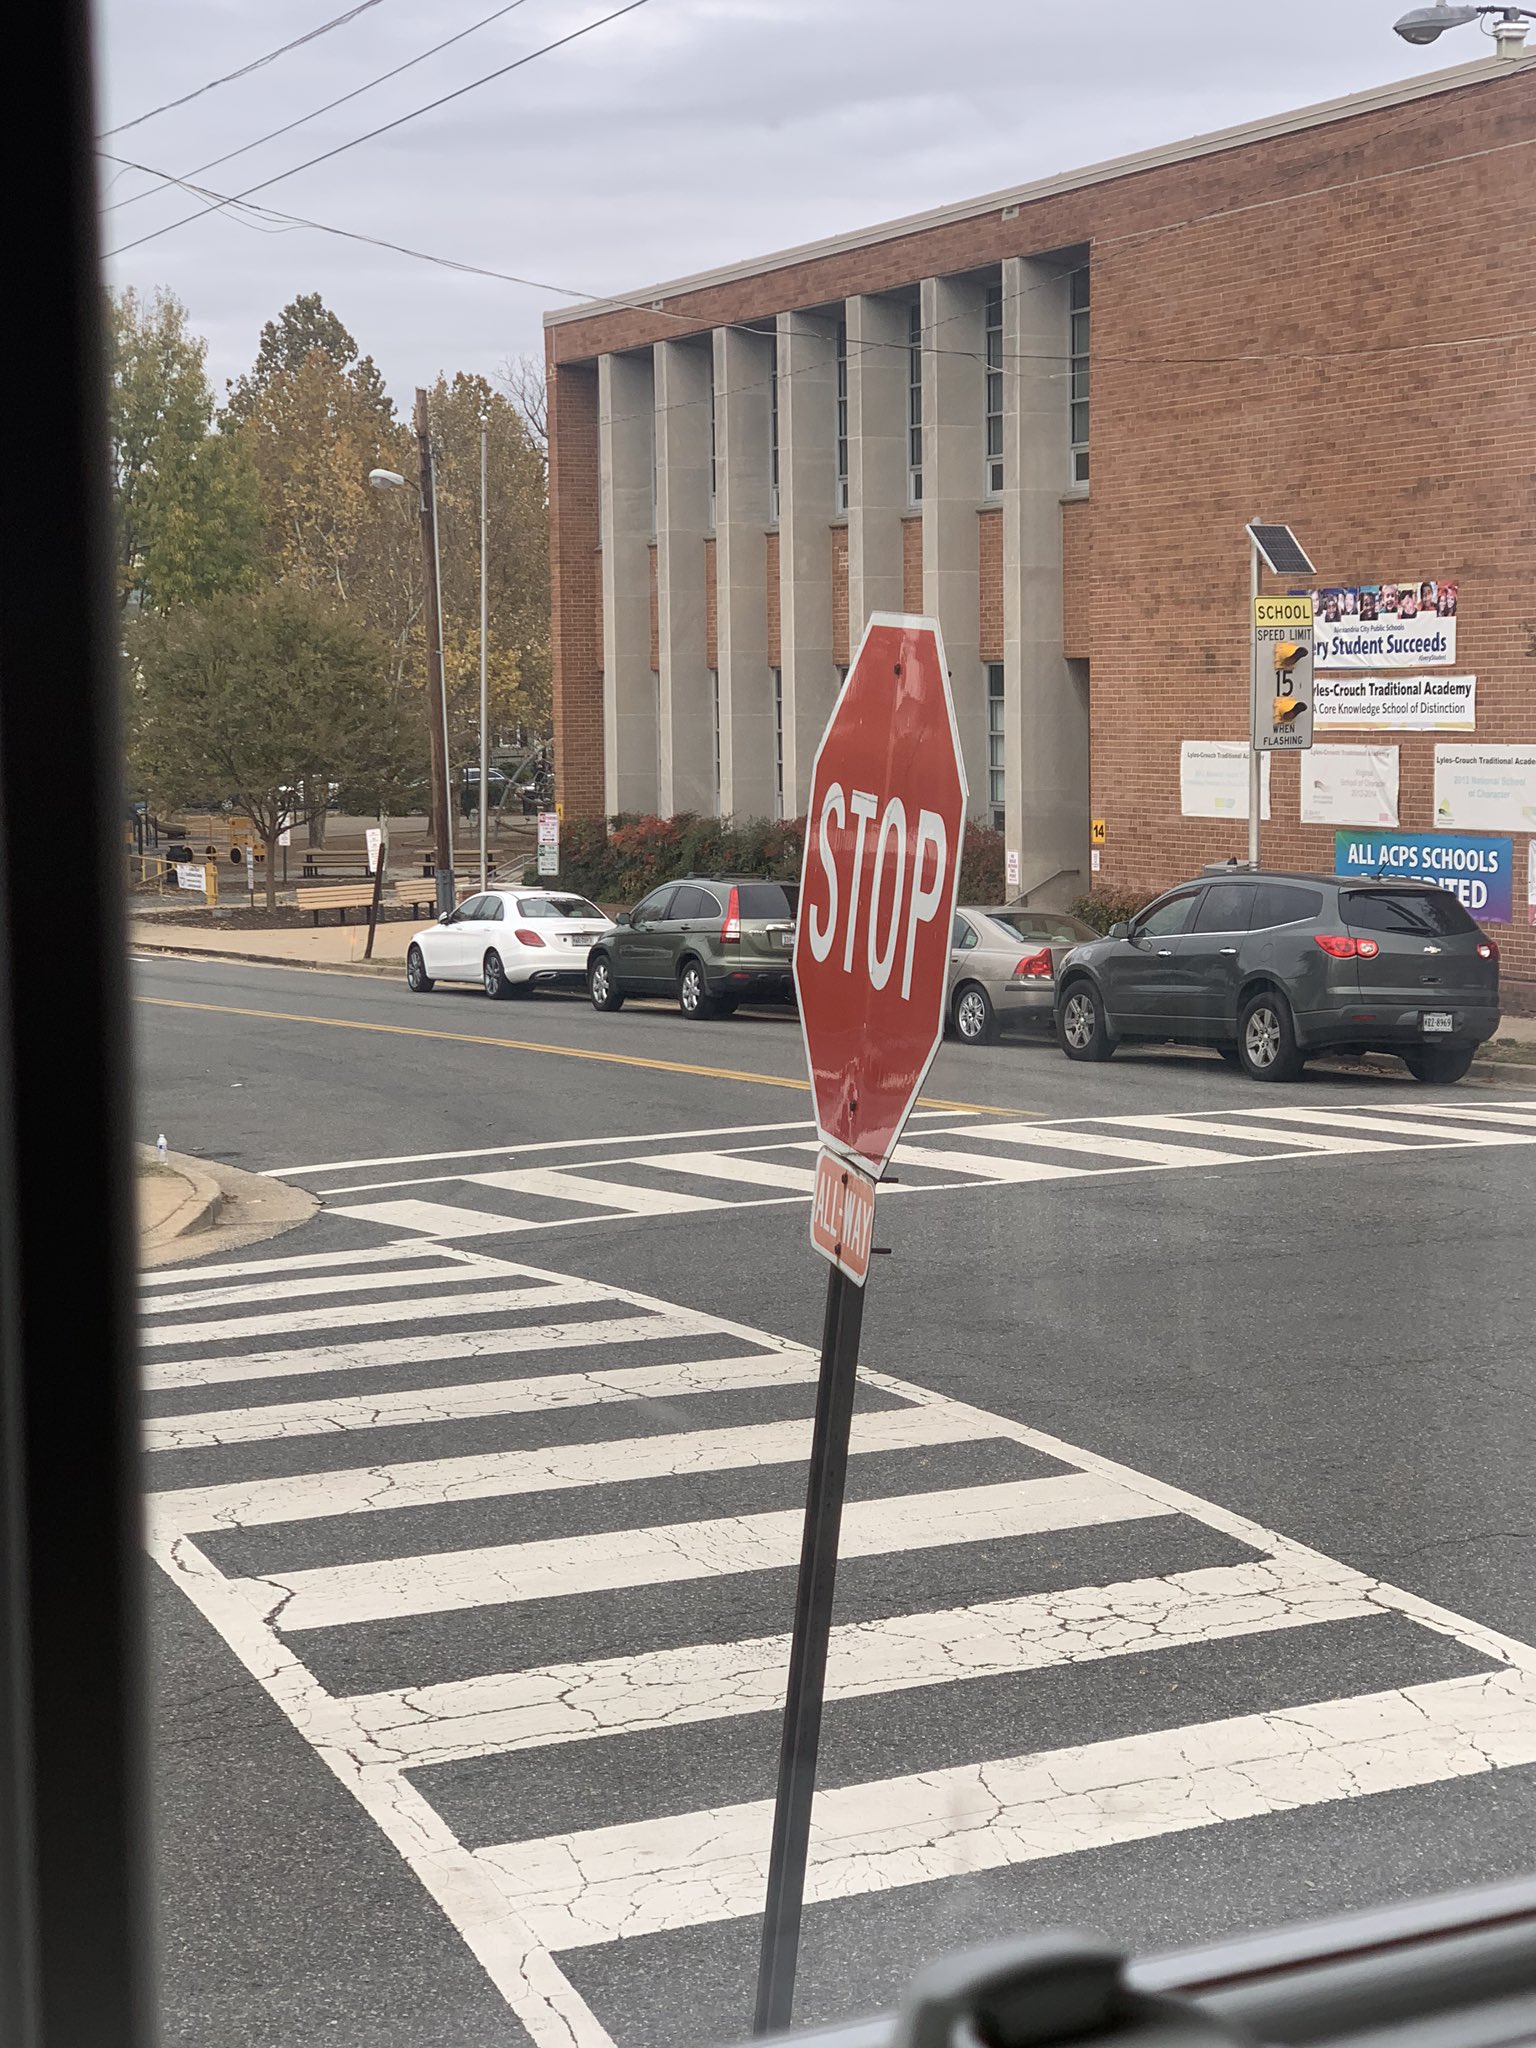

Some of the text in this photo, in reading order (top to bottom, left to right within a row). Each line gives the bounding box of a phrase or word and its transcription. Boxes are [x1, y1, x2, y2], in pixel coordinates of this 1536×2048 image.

[1258, 605, 1310, 619] SCHOOL
[1258, 629, 1311, 641] SPEED LIMIT
[1360, 624, 1370, 634] City
[1370, 623, 1385, 632] Public
[1386, 623, 1405, 632] Schools
[1332, 635, 1383, 655] Student
[1387, 632, 1447, 654] Succeeds
[1276, 670, 1293, 697] 15
[1369, 681, 1422, 696] Traditional
[1424, 681, 1472, 698] Academy
[1318, 703, 1337, 714] Core
[1338, 702, 1380, 716] Knowledge
[1382, 702, 1408, 714] School
[1411, 702, 1419, 714] of
[1420, 701, 1466, 714] Distinction
[1273, 724, 1296, 734] WHEN
[1263, 736, 1303, 746] FLASHING
[1436, 756, 1477, 765] Lyles-Crouch
[1479, 756, 1513, 765] Traditional
[1094, 824, 1105, 838] 14
[1347, 843, 1499, 873] ALL ACPS SCHOOLS
[808, 781, 946, 1001] STOP
[814, 1171, 873, 1260] ALL-WAY
